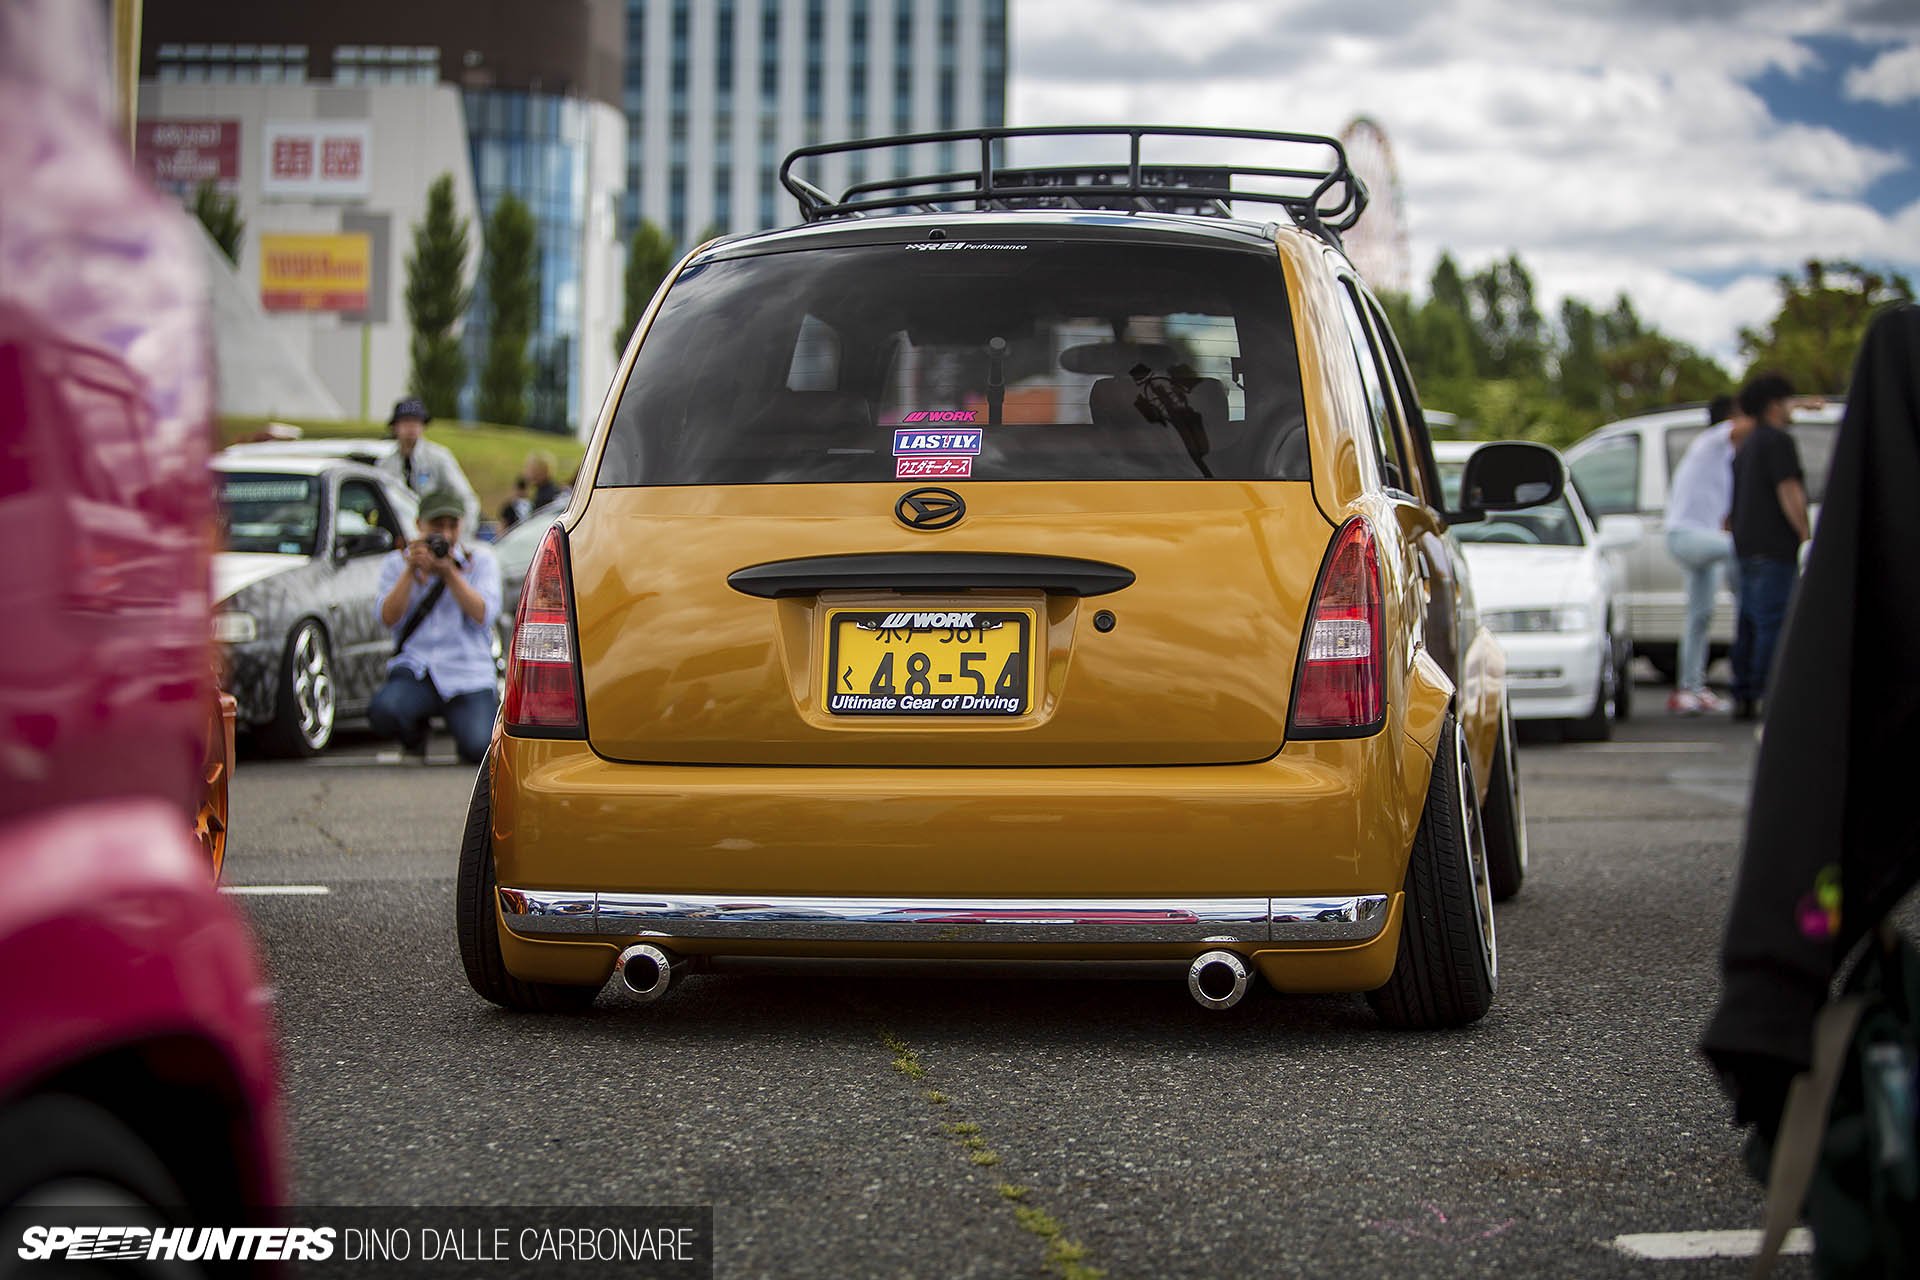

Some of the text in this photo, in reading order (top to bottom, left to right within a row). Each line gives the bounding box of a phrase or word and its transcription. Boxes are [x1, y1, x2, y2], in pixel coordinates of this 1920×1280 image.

[929, 411, 976, 422] WORK
[913, 613, 976, 627] WORK
[870, 652, 1020, 694] 48-54
[832, 696, 1019, 712] Ultimate Gear of Driving
